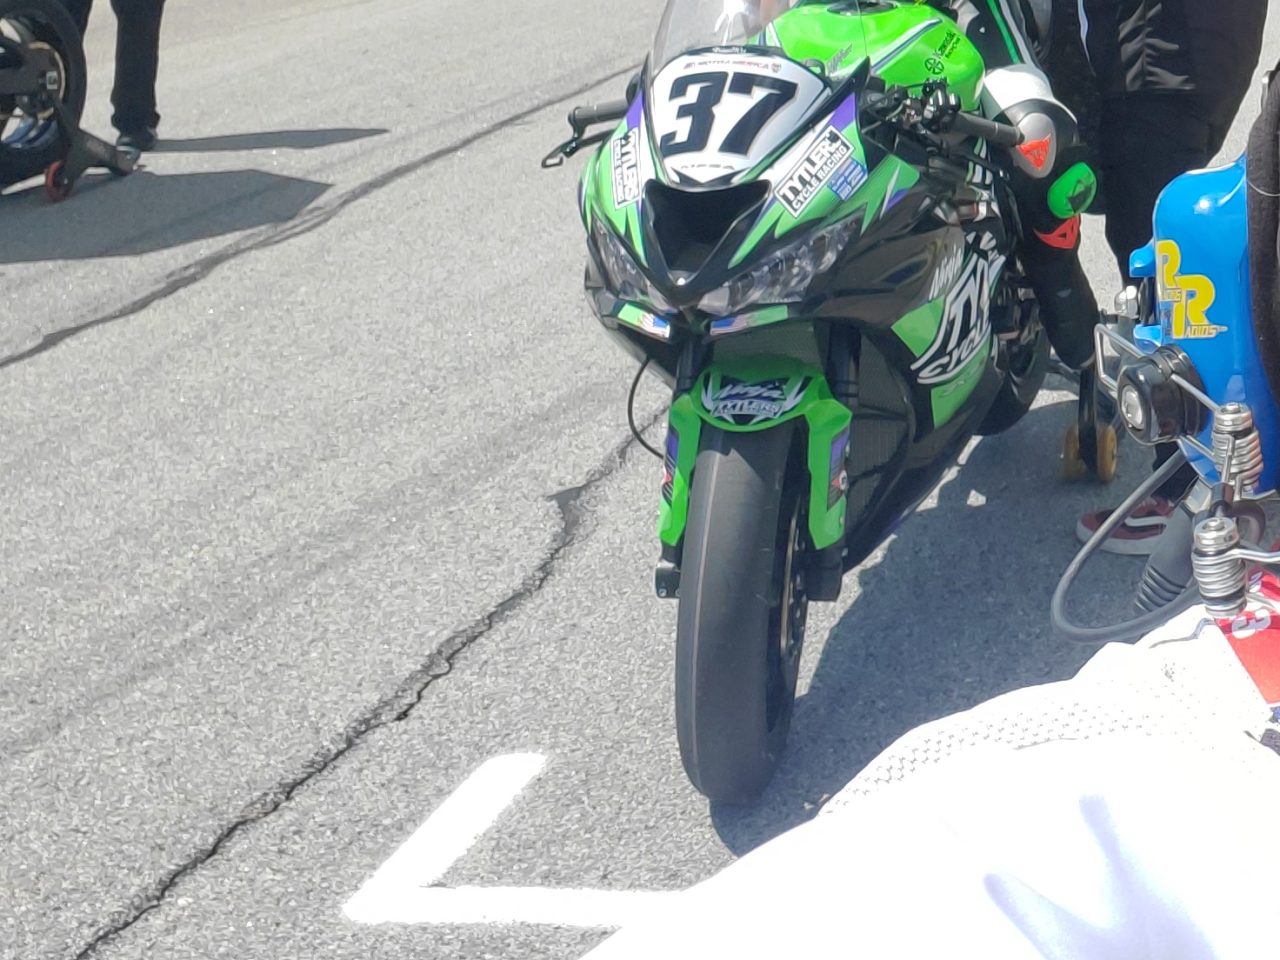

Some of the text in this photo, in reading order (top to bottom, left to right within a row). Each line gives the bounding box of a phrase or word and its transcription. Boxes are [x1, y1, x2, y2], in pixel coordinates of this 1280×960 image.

[659, 70, 799, 159] 37
[791, 144, 848, 210] CYCLE RACING
